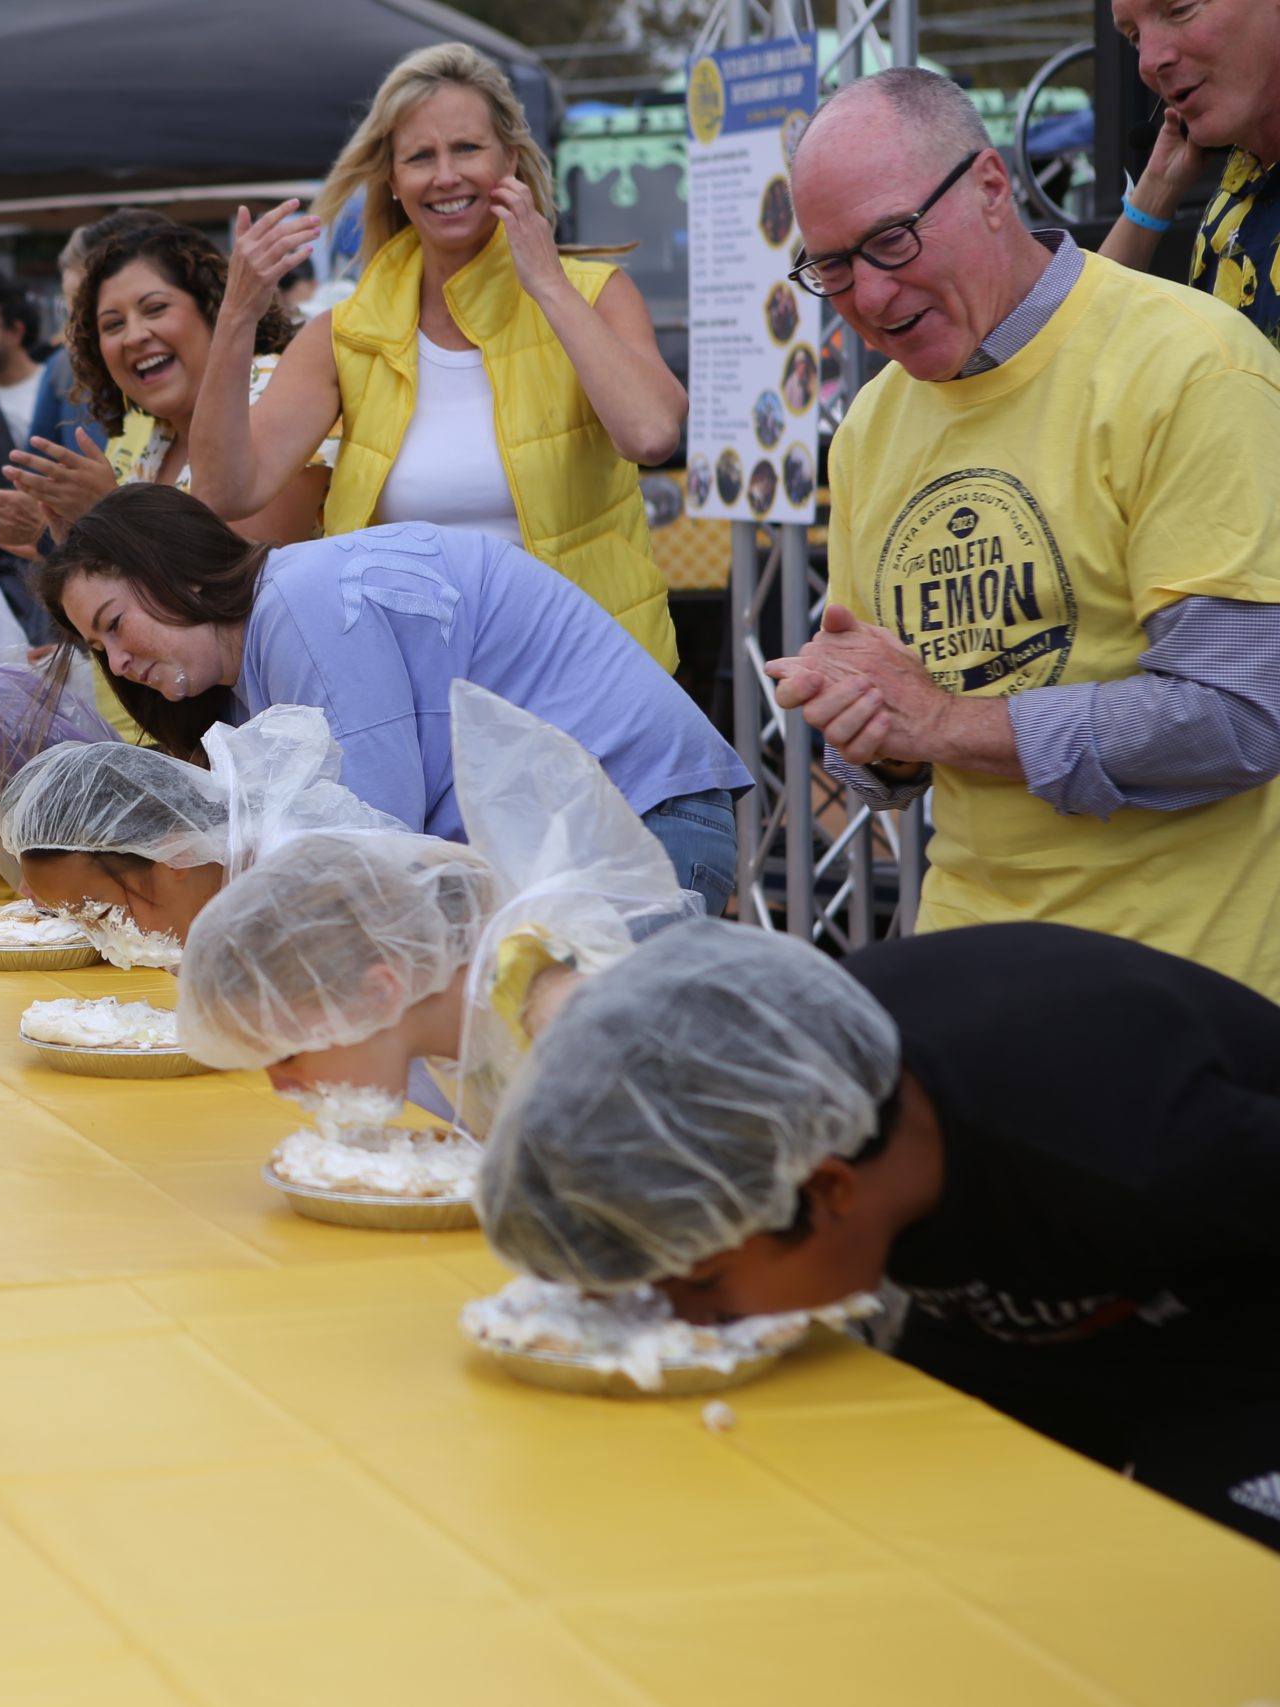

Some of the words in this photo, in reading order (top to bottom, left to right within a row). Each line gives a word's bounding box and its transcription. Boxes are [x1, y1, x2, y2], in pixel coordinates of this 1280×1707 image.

[893, 526, 920, 571] SANTA
[919, 493, 969, 526] BARBARA
[972, 491, 1010, 512] SOUTH
[902, 553, 926, 578] The
[928, 535, 1004, 576] GOLETA
[894, 562, 1043, 646] LEMON
[920, 627, 1008, 667] FESTIVAL
[984, 658, 1005, 681] 30
